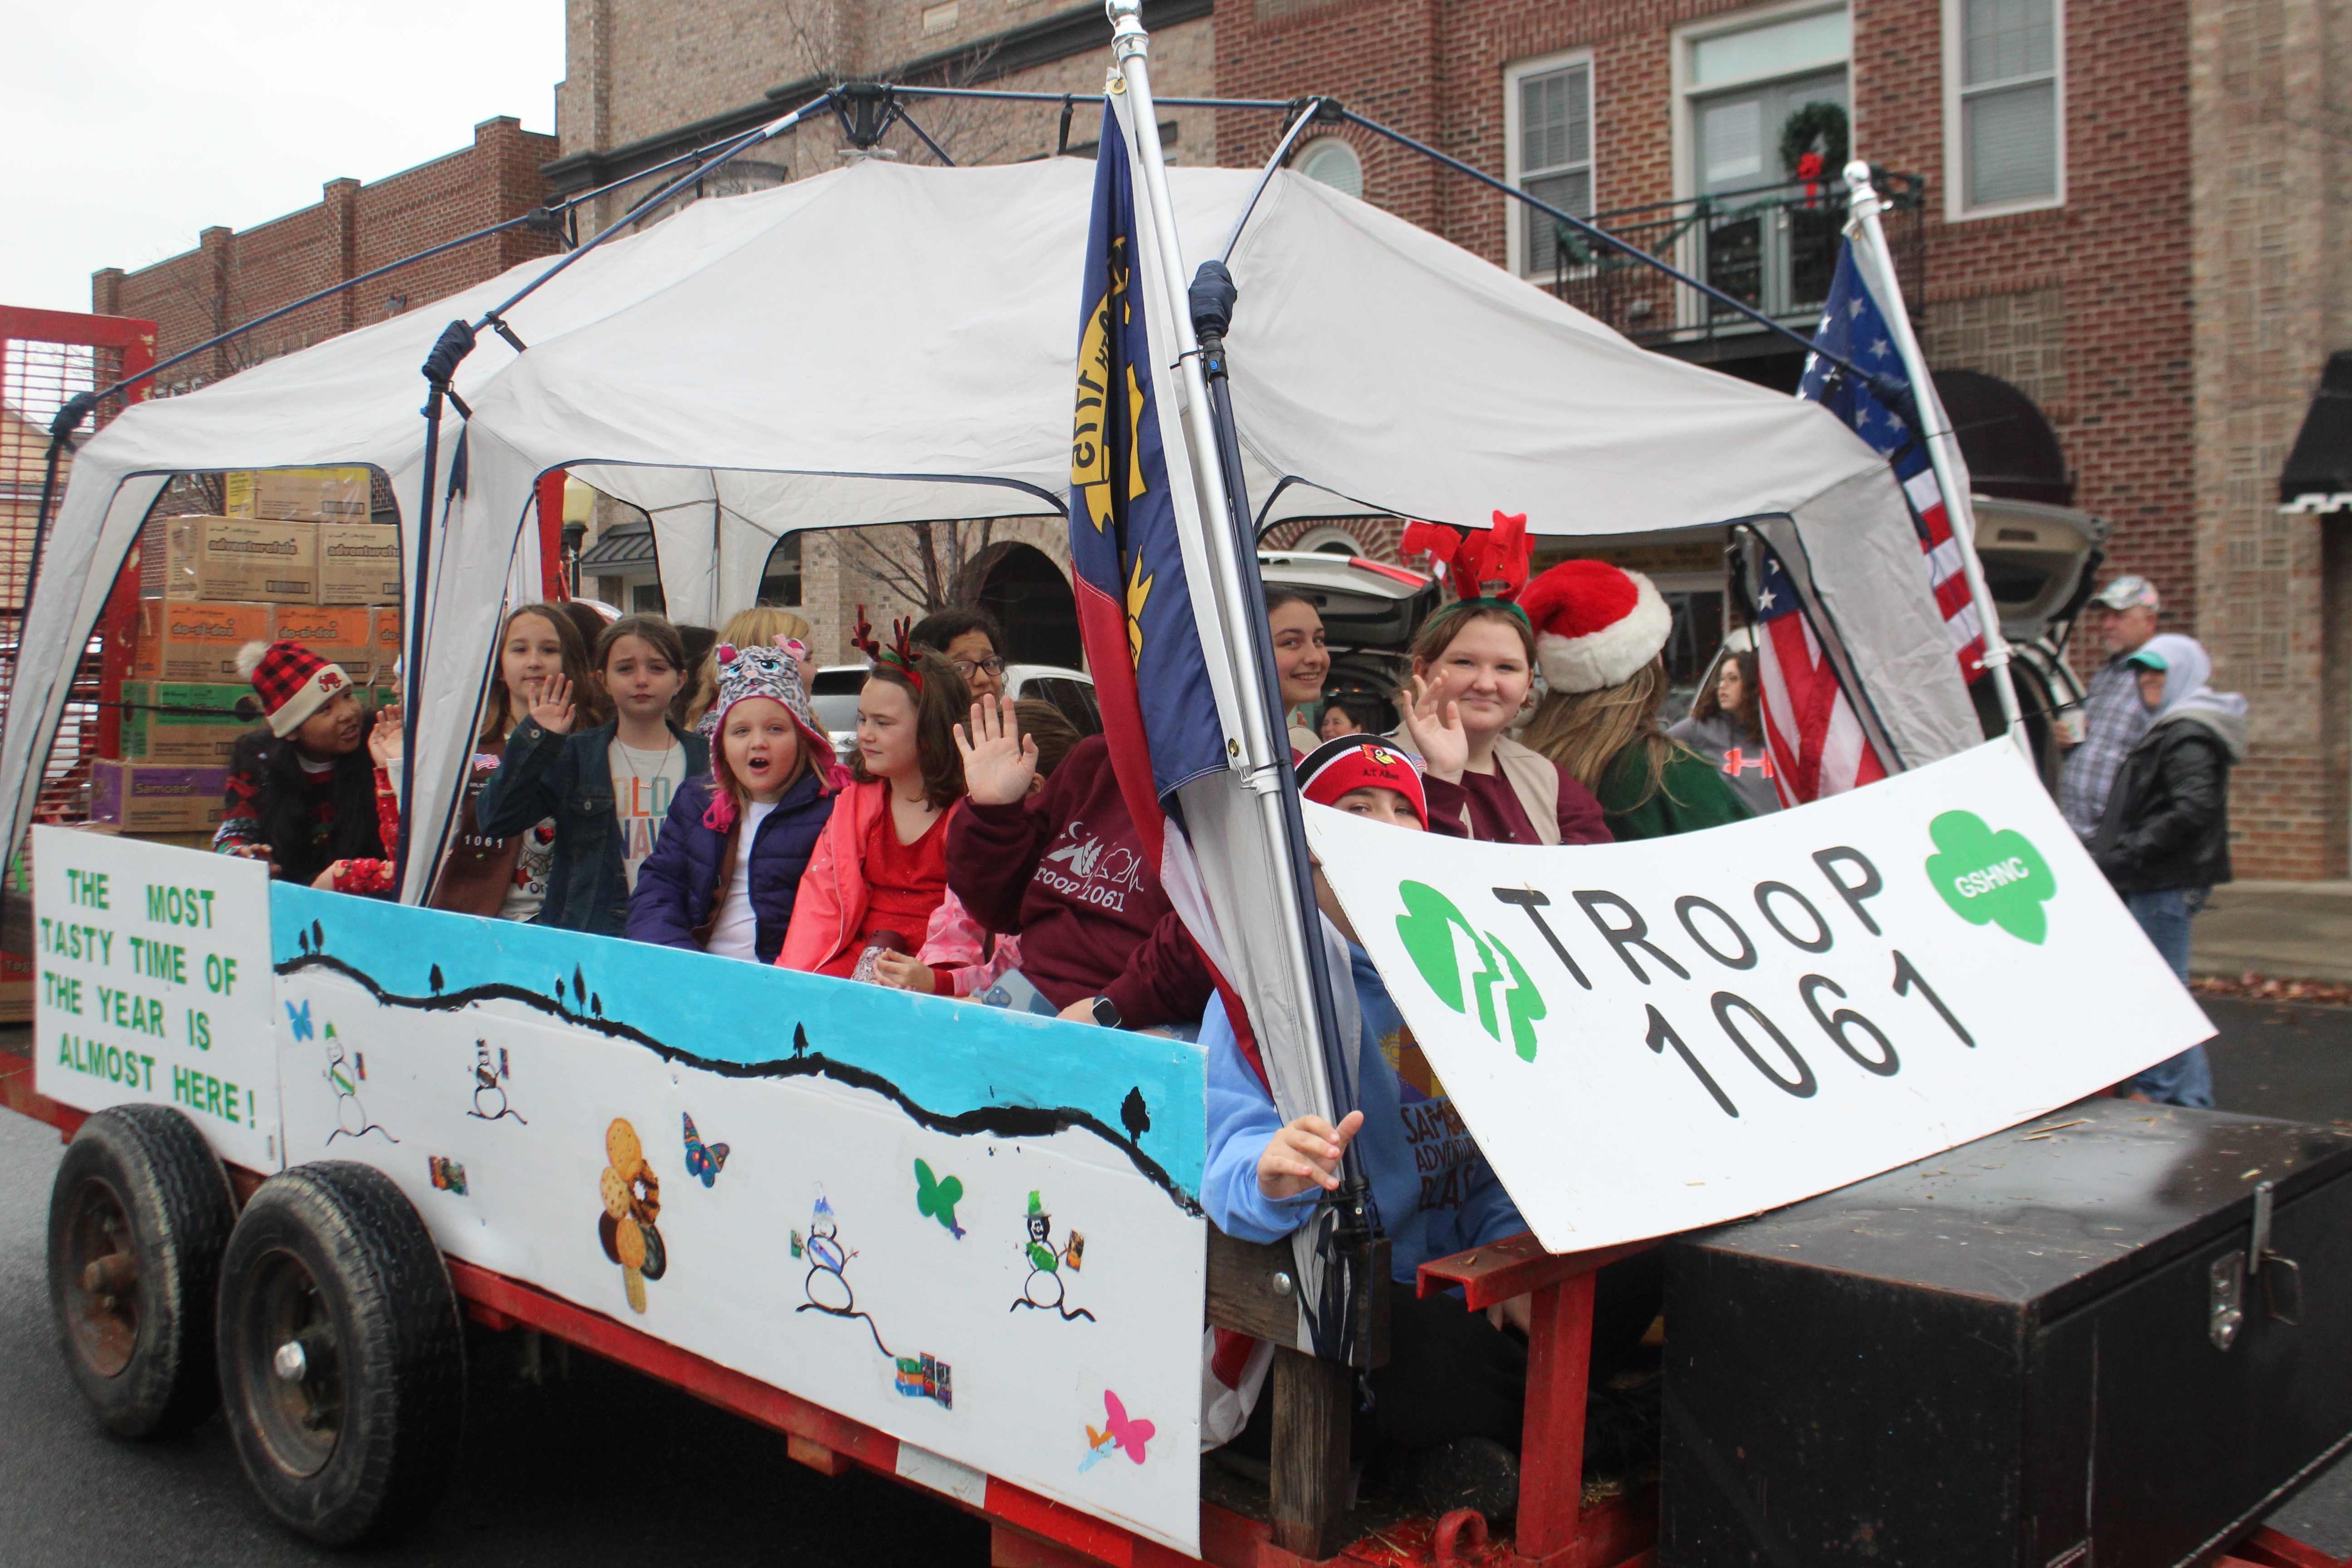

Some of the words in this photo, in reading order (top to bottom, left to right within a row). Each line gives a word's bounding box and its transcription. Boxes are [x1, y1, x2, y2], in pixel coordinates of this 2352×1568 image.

[464, 835, 504, 849] 1061
[66, 869, 110, 910] THE
[147, 884, 215, 929] MOST
[1033, 858, 1080, 895] roop
[1078, 885, 1124, 912] 1061
[1954, 857, 2029, 898] GSHNC
[1492, 846, 1882, 990] TROOP
[40, 917, 114, 965] TASTY
[129, 936, 187, 985] TIME
[205, 953, 238, 996] OF
[43, 971, 83, 1015] THE
[97, 985, 165, 1038] YEAR
[187, 1009, 211, 1051] IS
[1645, 950, 1977, 1119] 1061
[58, 1033, 156, 1092] ALMOST
[1414, 1137, 1480, 1172] ADVENTUR
